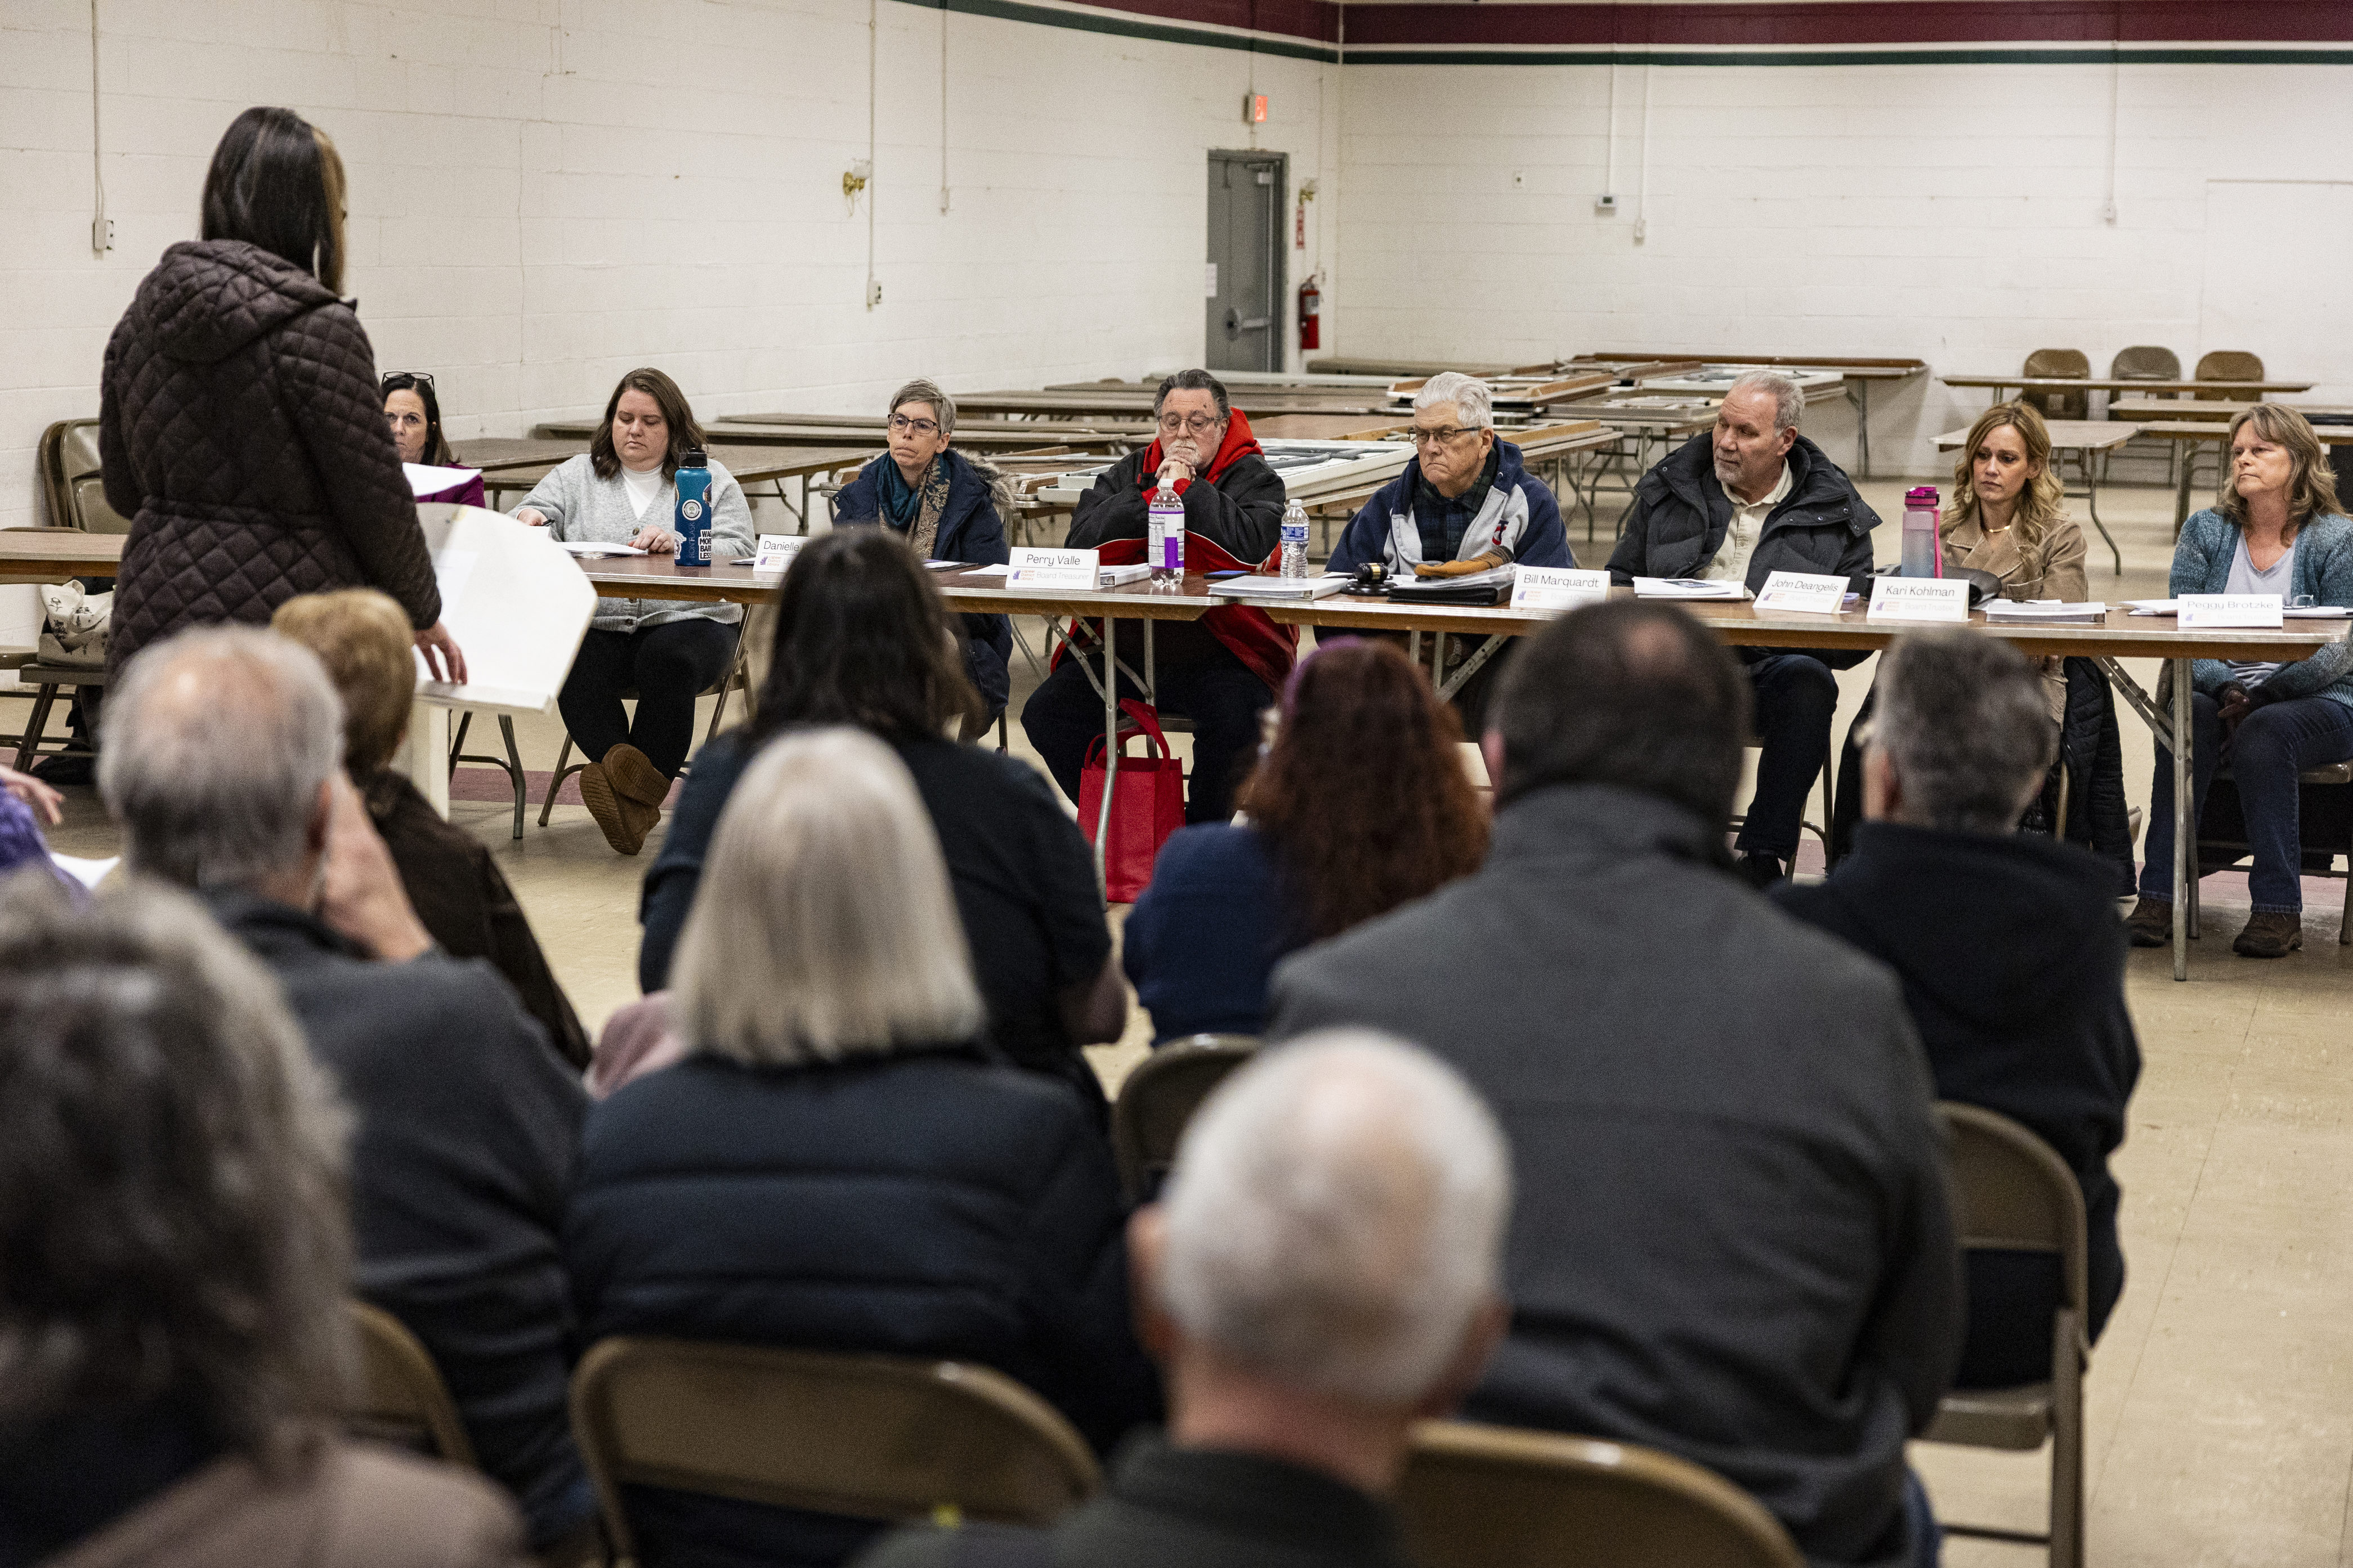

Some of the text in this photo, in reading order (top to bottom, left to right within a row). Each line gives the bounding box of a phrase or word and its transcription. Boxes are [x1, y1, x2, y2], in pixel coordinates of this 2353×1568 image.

[763, 540, 799, 552] Danielle
[1026, 554, 1080, 566] Perry Valle
[1523, 574, 1599, 588] Bill Marquardt
[1772, 579, 1838, 593] John Deangelis
[1886, 585, 1954, 597] Kari Kohlman
